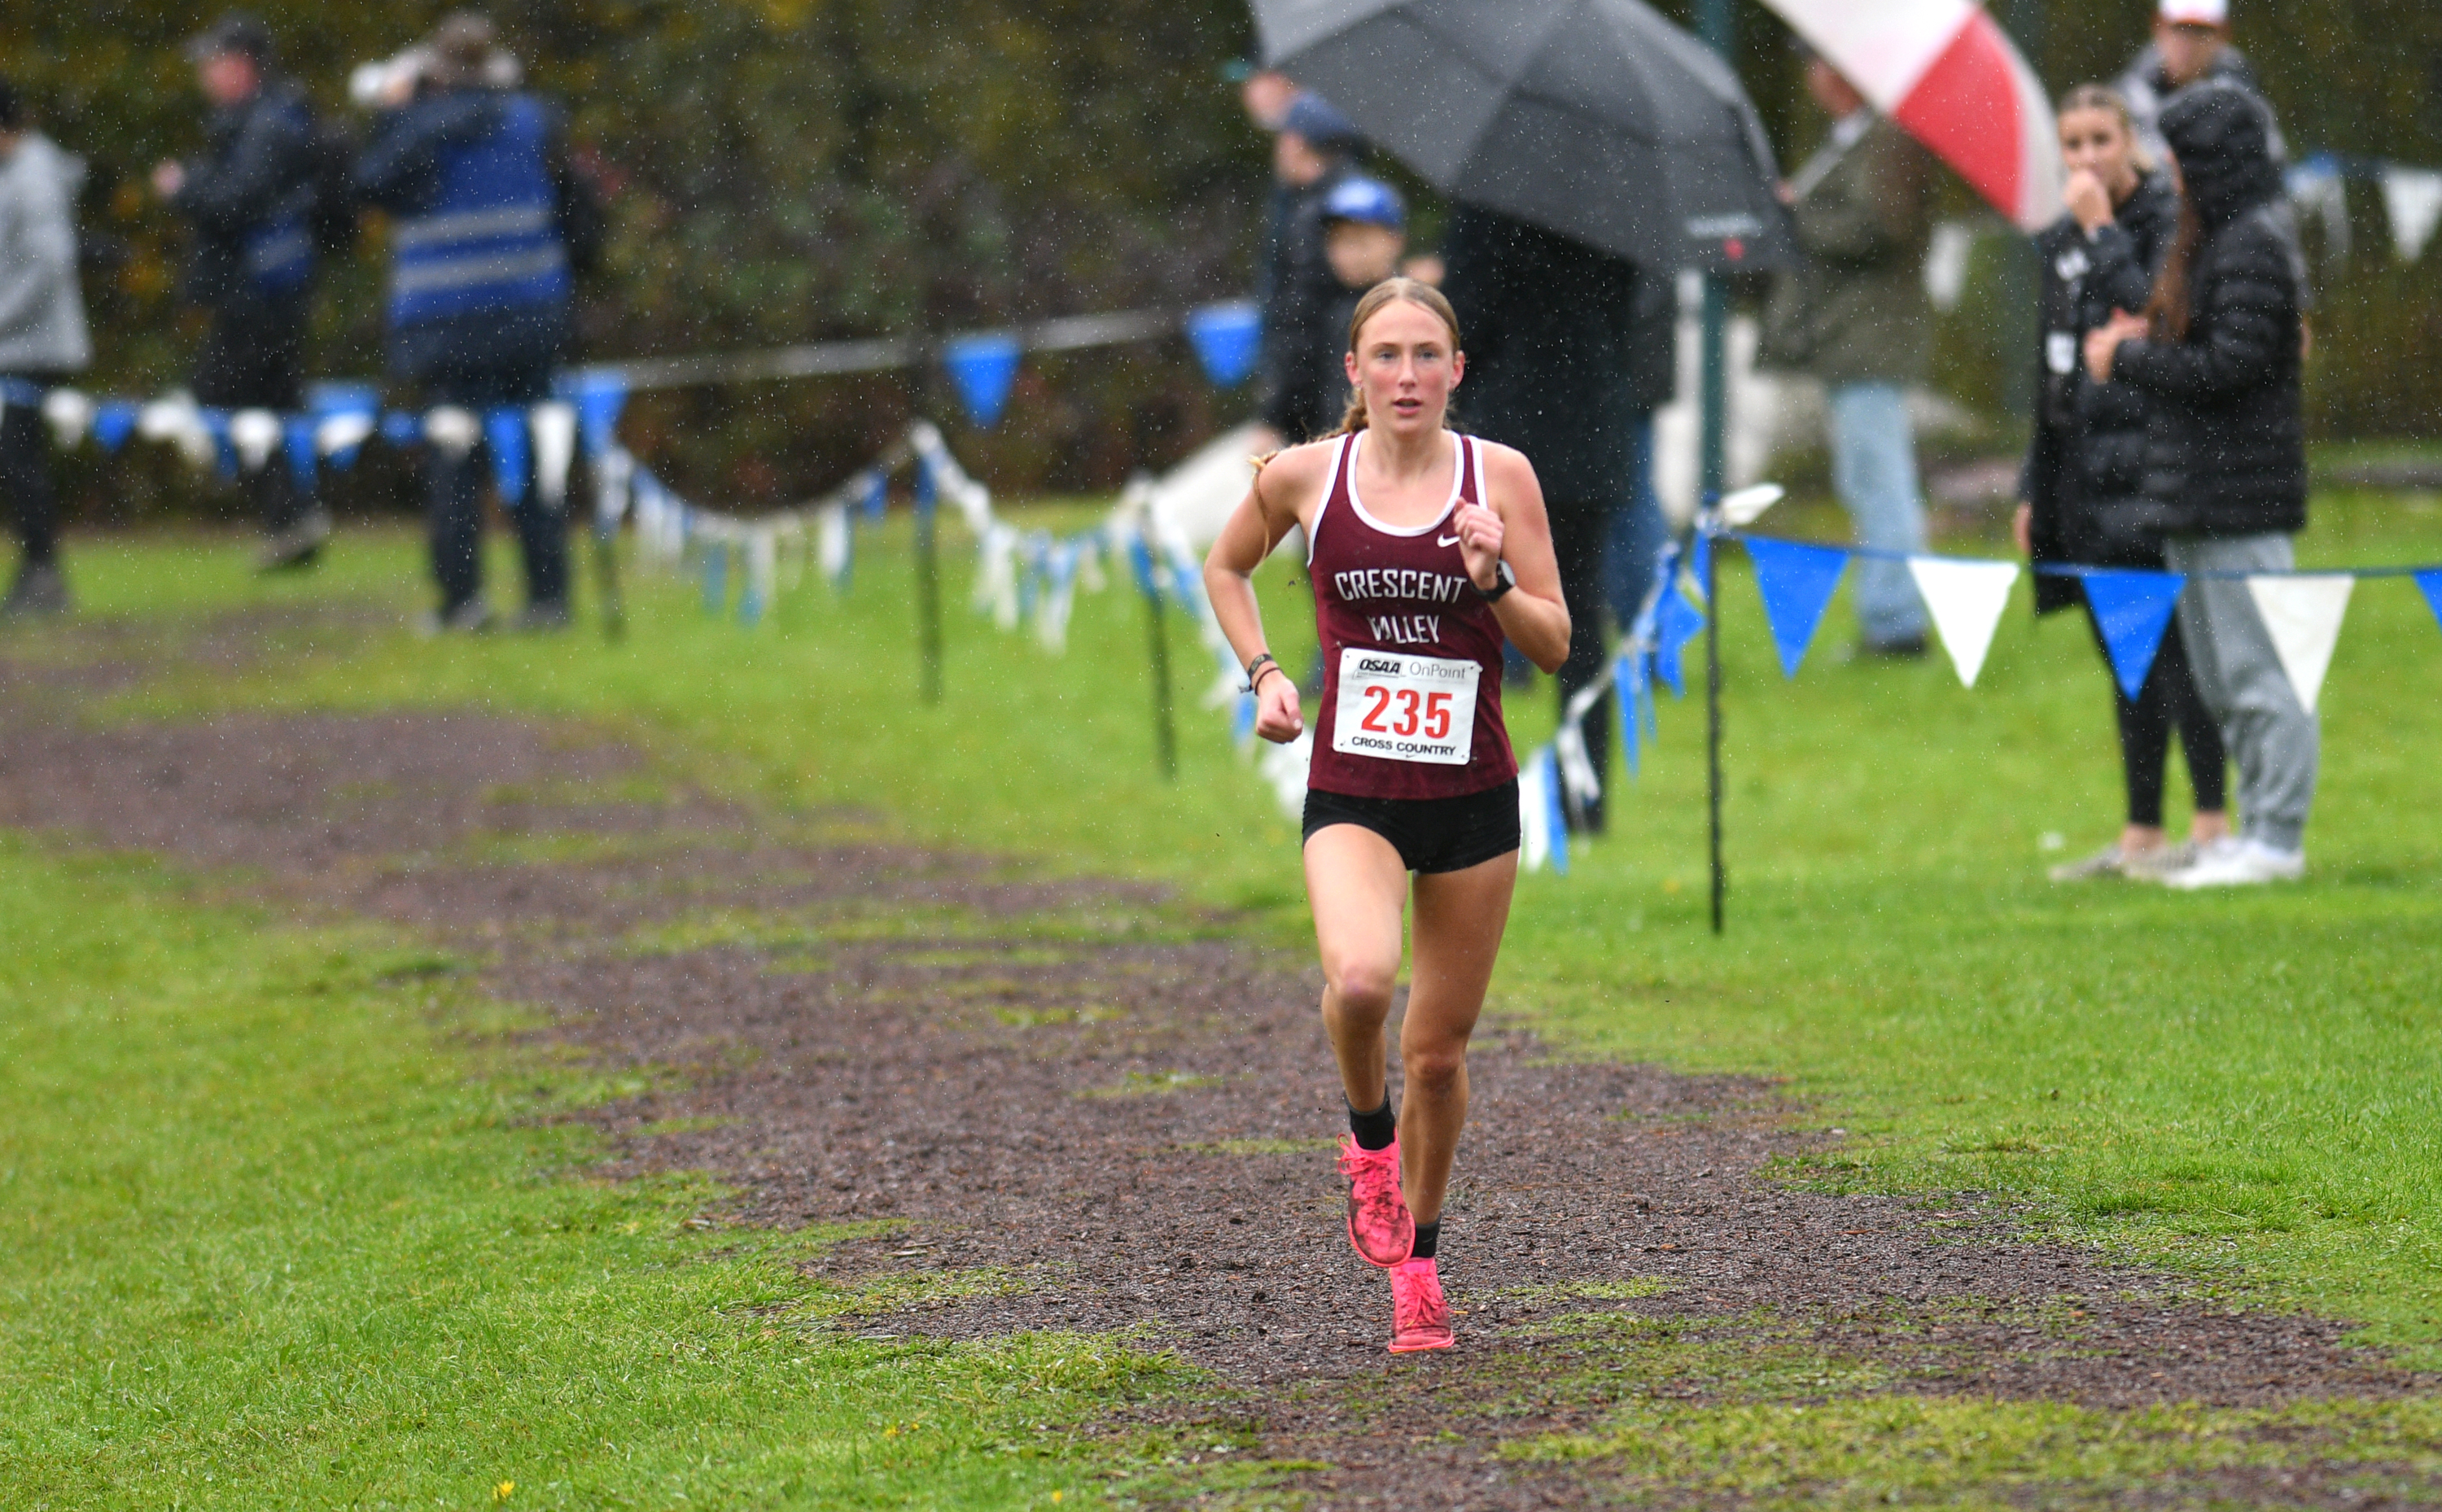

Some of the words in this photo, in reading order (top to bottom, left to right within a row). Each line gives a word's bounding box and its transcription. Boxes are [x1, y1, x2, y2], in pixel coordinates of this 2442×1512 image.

[1334, 569, 1467, 603] CRESCENT
[1359, 659, 1401, 674] OSAA
[1410, 662, 1467, 680] OnPoint
[1361, 685, 1453, 739] 235
[1352, 736, 1393, 750] CROSS
[1396, 742, 1456, 756] COUNTRY
